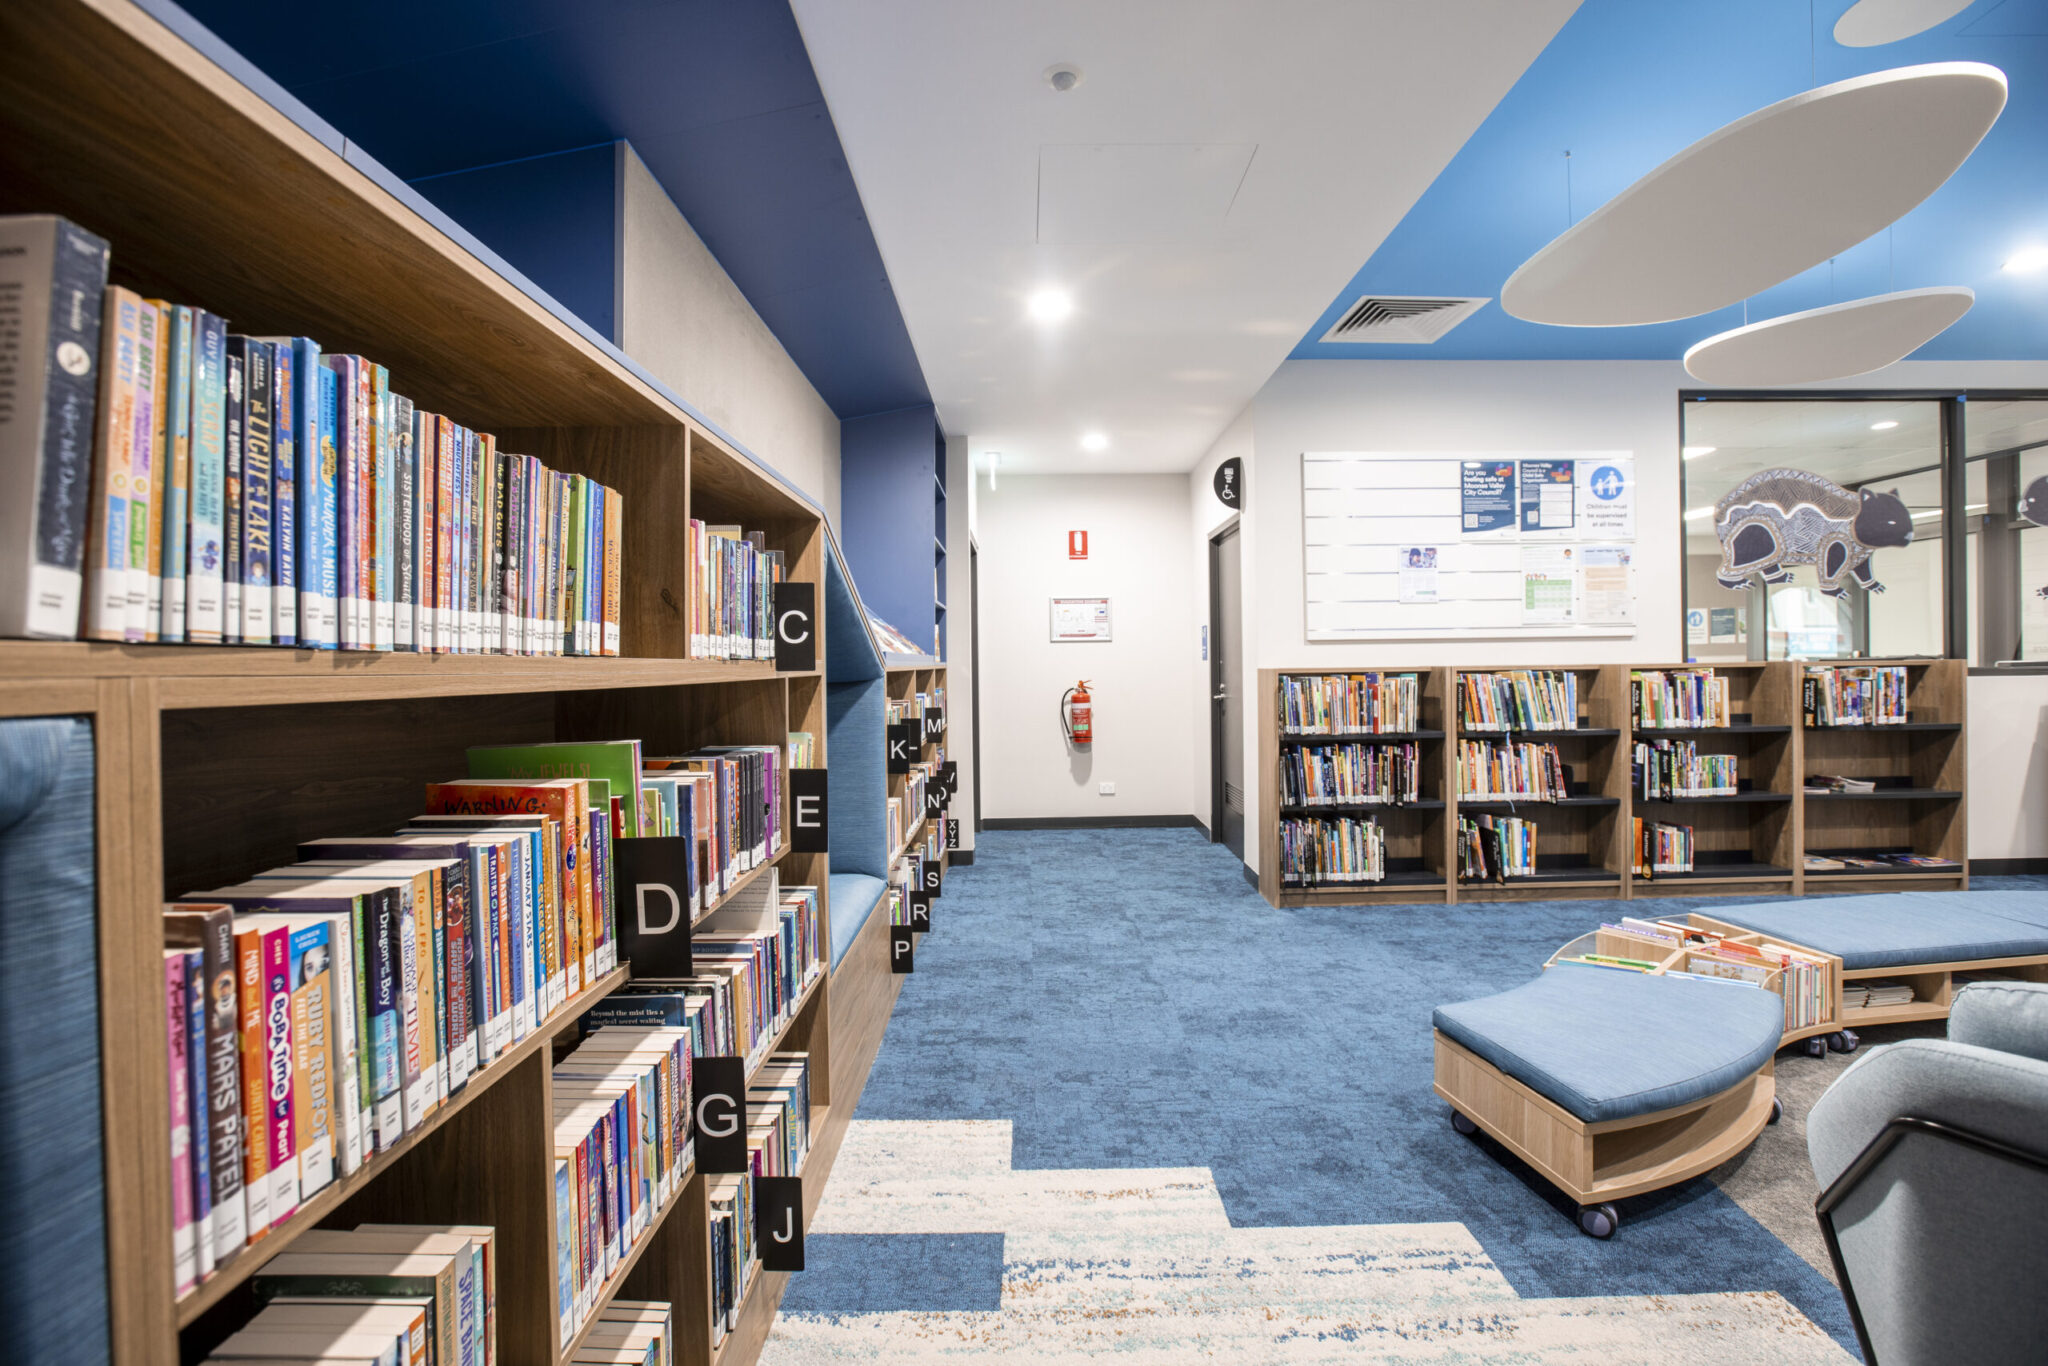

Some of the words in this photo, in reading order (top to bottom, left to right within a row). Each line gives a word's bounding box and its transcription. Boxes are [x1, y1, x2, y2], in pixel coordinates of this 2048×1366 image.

[121, 301, 137, 333] ASH
[139, 311, 154, 341] ASH
[119, 334, 134, 386] BARTY
[205, 330, 218, 358] GUY
[139, 343, 153, 393] BARTY
[205, 359, 218, 398] BASS
[199, 400, 221, 455] SCRAP
[247, 416, 271, 480] LIGHT
[454, 440, 462, 497] NAUGHTIEST
[496, 482, 504, 509] BAD
[1488, 483, 1506, 491] Valley
[321, 487, 337, 549] MURDER
[402, 471, 412, 545] SISTERHOOD
[247, 500, 270, 554] LAKE
[281, 504, 292, 551] KALYNN
[495, 511, 503, 549] GUYS
[510, 515, 518, 550] GUYS
[778, 609, 809, 643] C
[1457, 685, 1465, 712] Animals
[926, 718, 942, 734] M
[890, 740, 908, 760] K
[796, 795, 821, 828] E
[927, 793, 941, 809] N
[949, 820, 956, 829] X
[949, 829, 956, 838] Y
[949, 838, 956, 847] Z
[417, 887, 426, 904] TO
[926, 871, 939, 887] S
[382, 897, 390, 912] The
[499, 872, 508, 922] MASHER
[636, 883, 680, 935] D
[912, 903, 928, 921] R
[463, 899, 472, 936] TWINS
[218, 924, 229, 963] CHARI
[273, 939, 282, 966] CHEN
[378, 913, 391, 961] Dragon
[419, 932, 427, 958] FRO
[894, 940, 910, 960] P
[244, 950, 260, 986] MIND
[403, 932, 412, 993] THROUGH
[450, 941, 458, 987] SAVES
[456, 938, 464, 991] ROSWELL
[247, 987, 258, 1009] and
[296, 998, 308, 1019] FEEL
[379, 979, 393, 1006] Boy
[246, 1009, 260, 1031] ME
[307, 985, 324, 1048] RUBY
[384, 1012, 392, 1043] PENNY
[451, 1001, 459, 1046] WORLD
[591, 1009, 615, 1018] Beyond
[616, 1009, 627, 1017] the
[629, 1008, 645, 1017] mist
[646, 1008, 658, 1017] lies
[640, 1017, 667, 1026] waiting
[297, 1022, 308, 1041] THE
[406, 1000, 420, 1073] TIME
[210, 1031, 236, 1112] MARS
[298, 1044, 309, 1071] FEAR
[250, 1078, 264, 1123] SUNITA
[696, 1093, 739, 1139] G
[277, 1119, 290, 1161] Pearl
[212, 1114, 239, 1205] PATEL
[588, 1177, 598, 1225] WILD
[772, 1206, 793, 1244] J
[459, 1266, 474, 1330] SPACE
